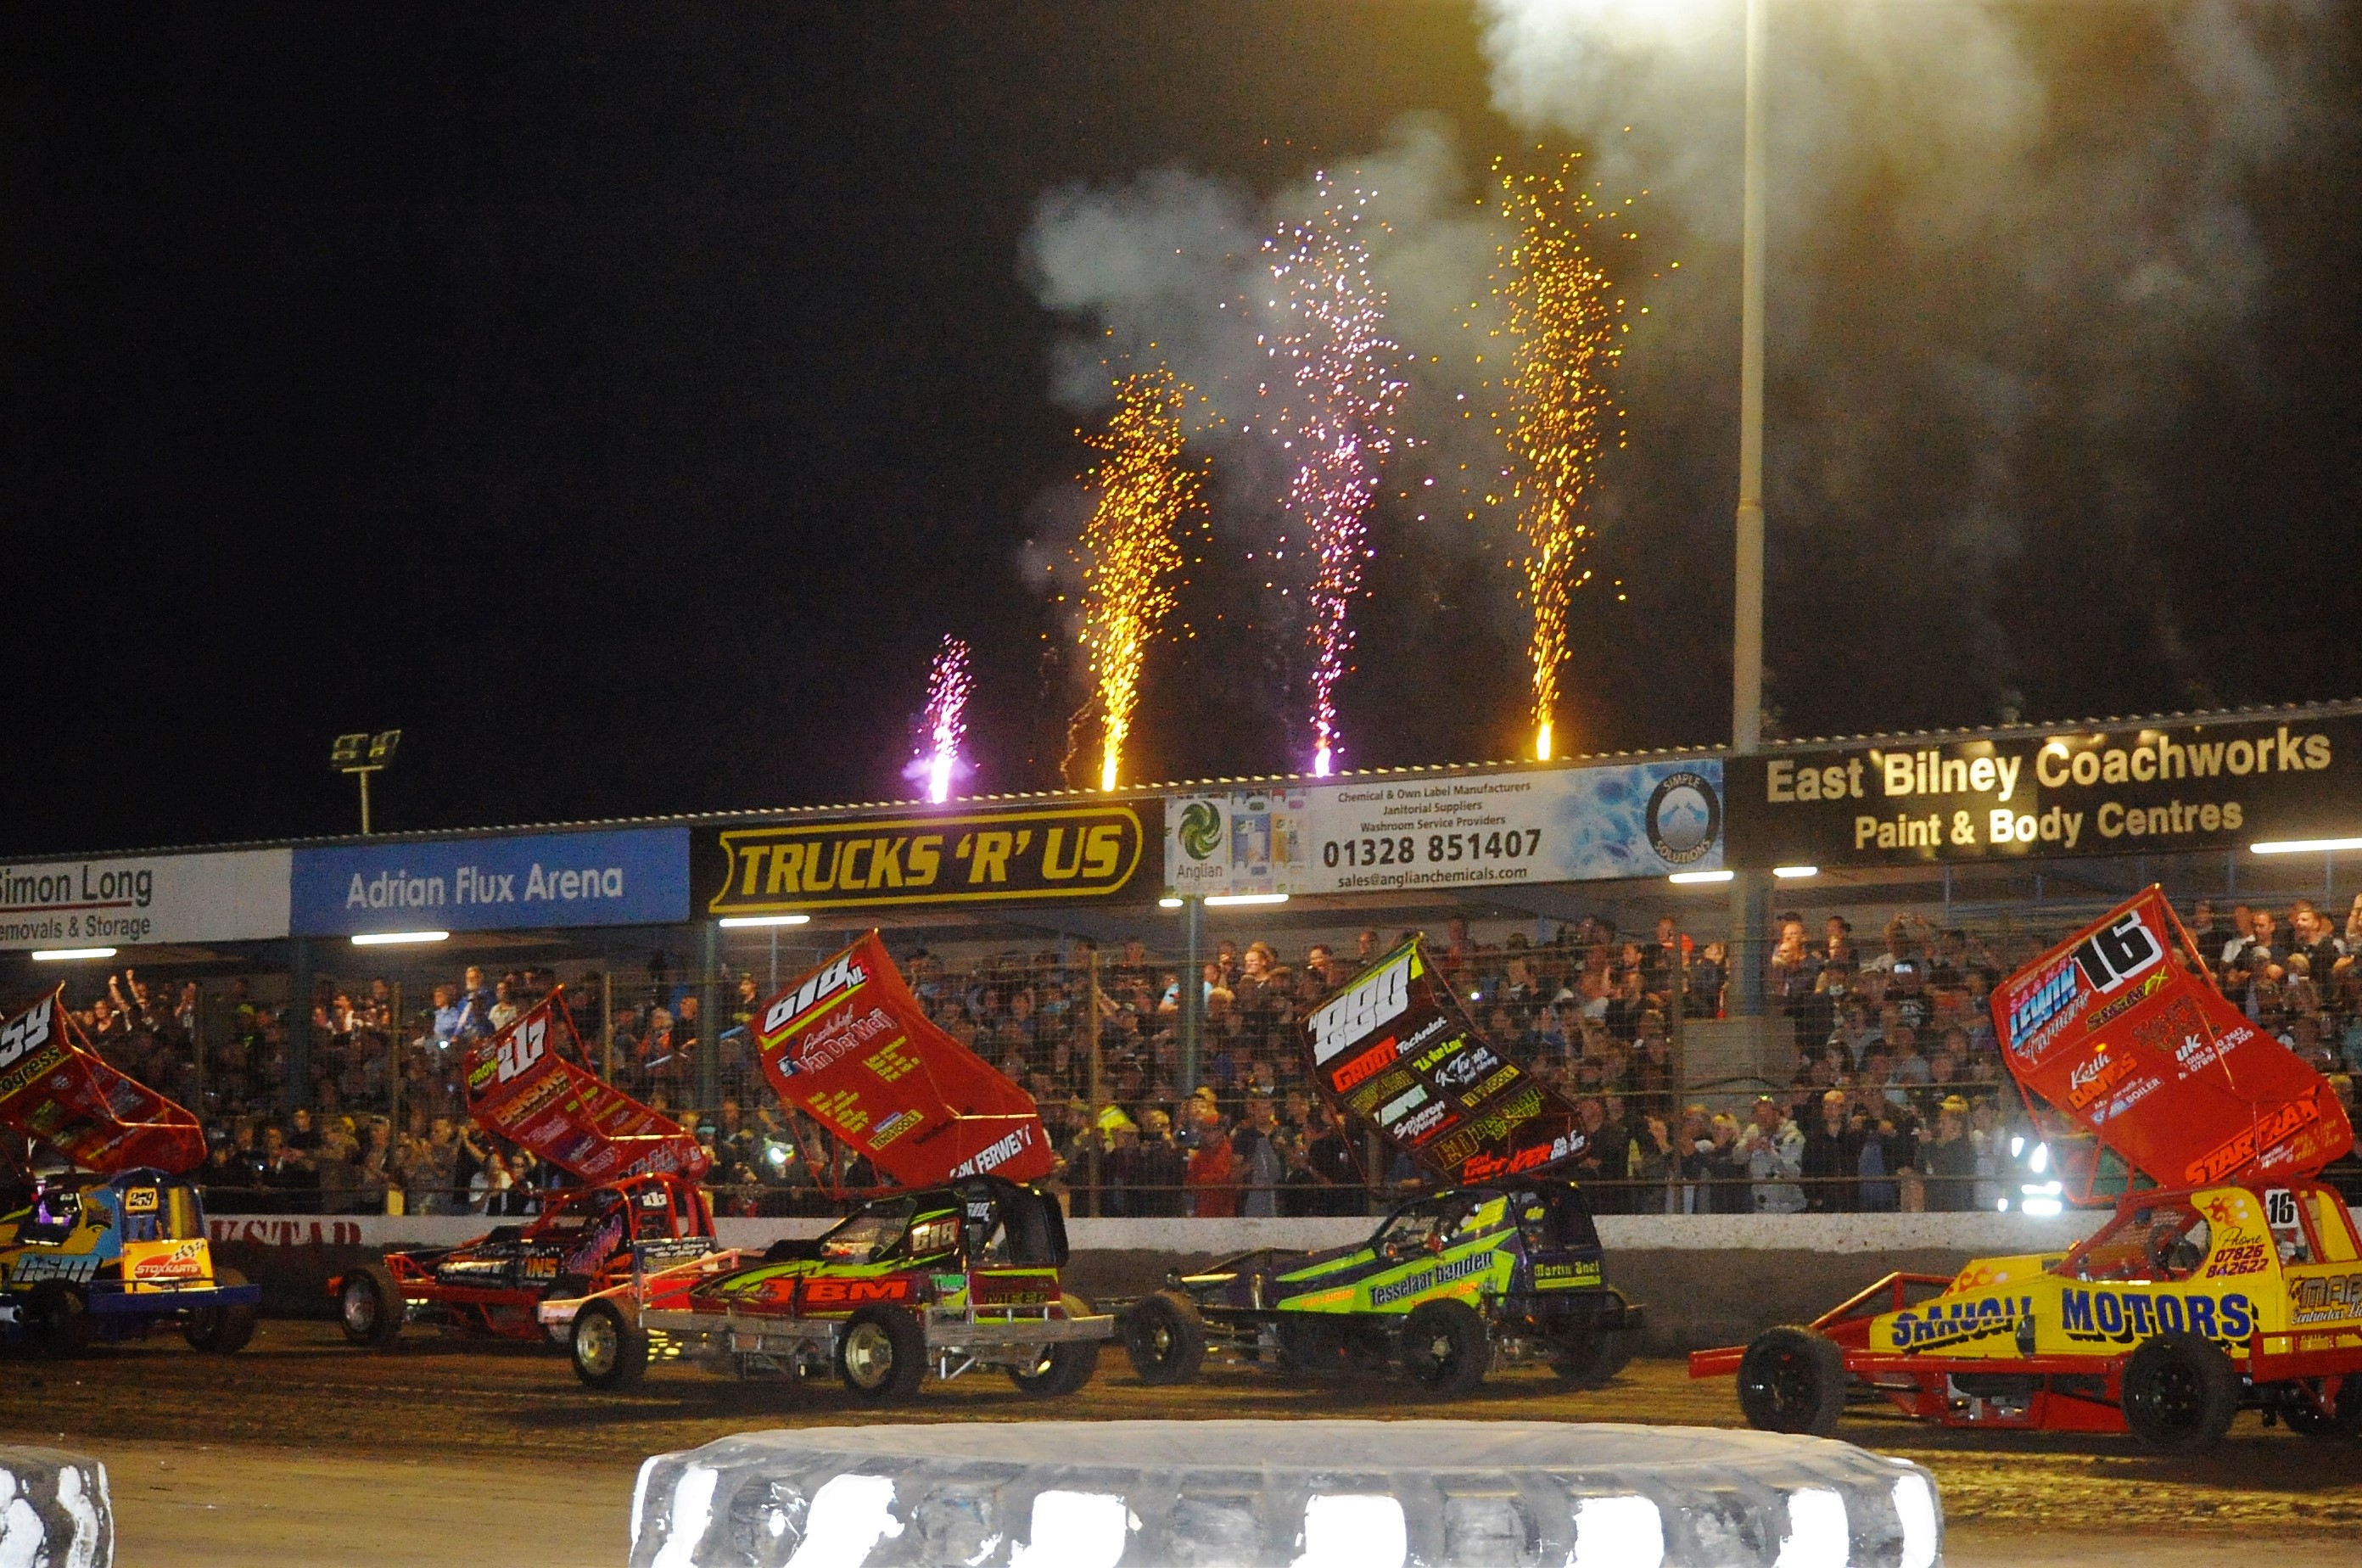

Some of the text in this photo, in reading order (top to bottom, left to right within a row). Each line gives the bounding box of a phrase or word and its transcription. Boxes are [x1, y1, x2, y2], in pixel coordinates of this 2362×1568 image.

[1767, 726, 2332, 804] East Bilney Coachworks
[1337, 781, 1531, 804] Chemical & Own Label Manufacturers
[1383, 800, 1483, 815] Janitorial Suppliers
[1361, 815, 1506, 832] Washroom Service Providers
[1855, 798, 2244, 849] Paint & Body Centres
[738, 833, 946, 896] TRUCKS
[1042, 823, 1123, 881] US
[1323, 828, 1542, 868] 01328 851407
[0, 864, 153, 908] imon Long
[346, 863, 624, 910] Adrian Flux Arena
[1177, 864, 1223, 882] Anglian
[1338, 866, 1528, 888] sales@anglianchemicals.com
[69, 916, 80, 938] &
[86, 914, 151, 942] Storage
[2069, 909, 2163, 994] 16
[2269, 1192, 2296, 1224] 16
[911, 1221, 956, 1252] 618
[2219, 1226, 2263, 1247] Phone
[2061, 1287, 2253, 1340] MOTORS
